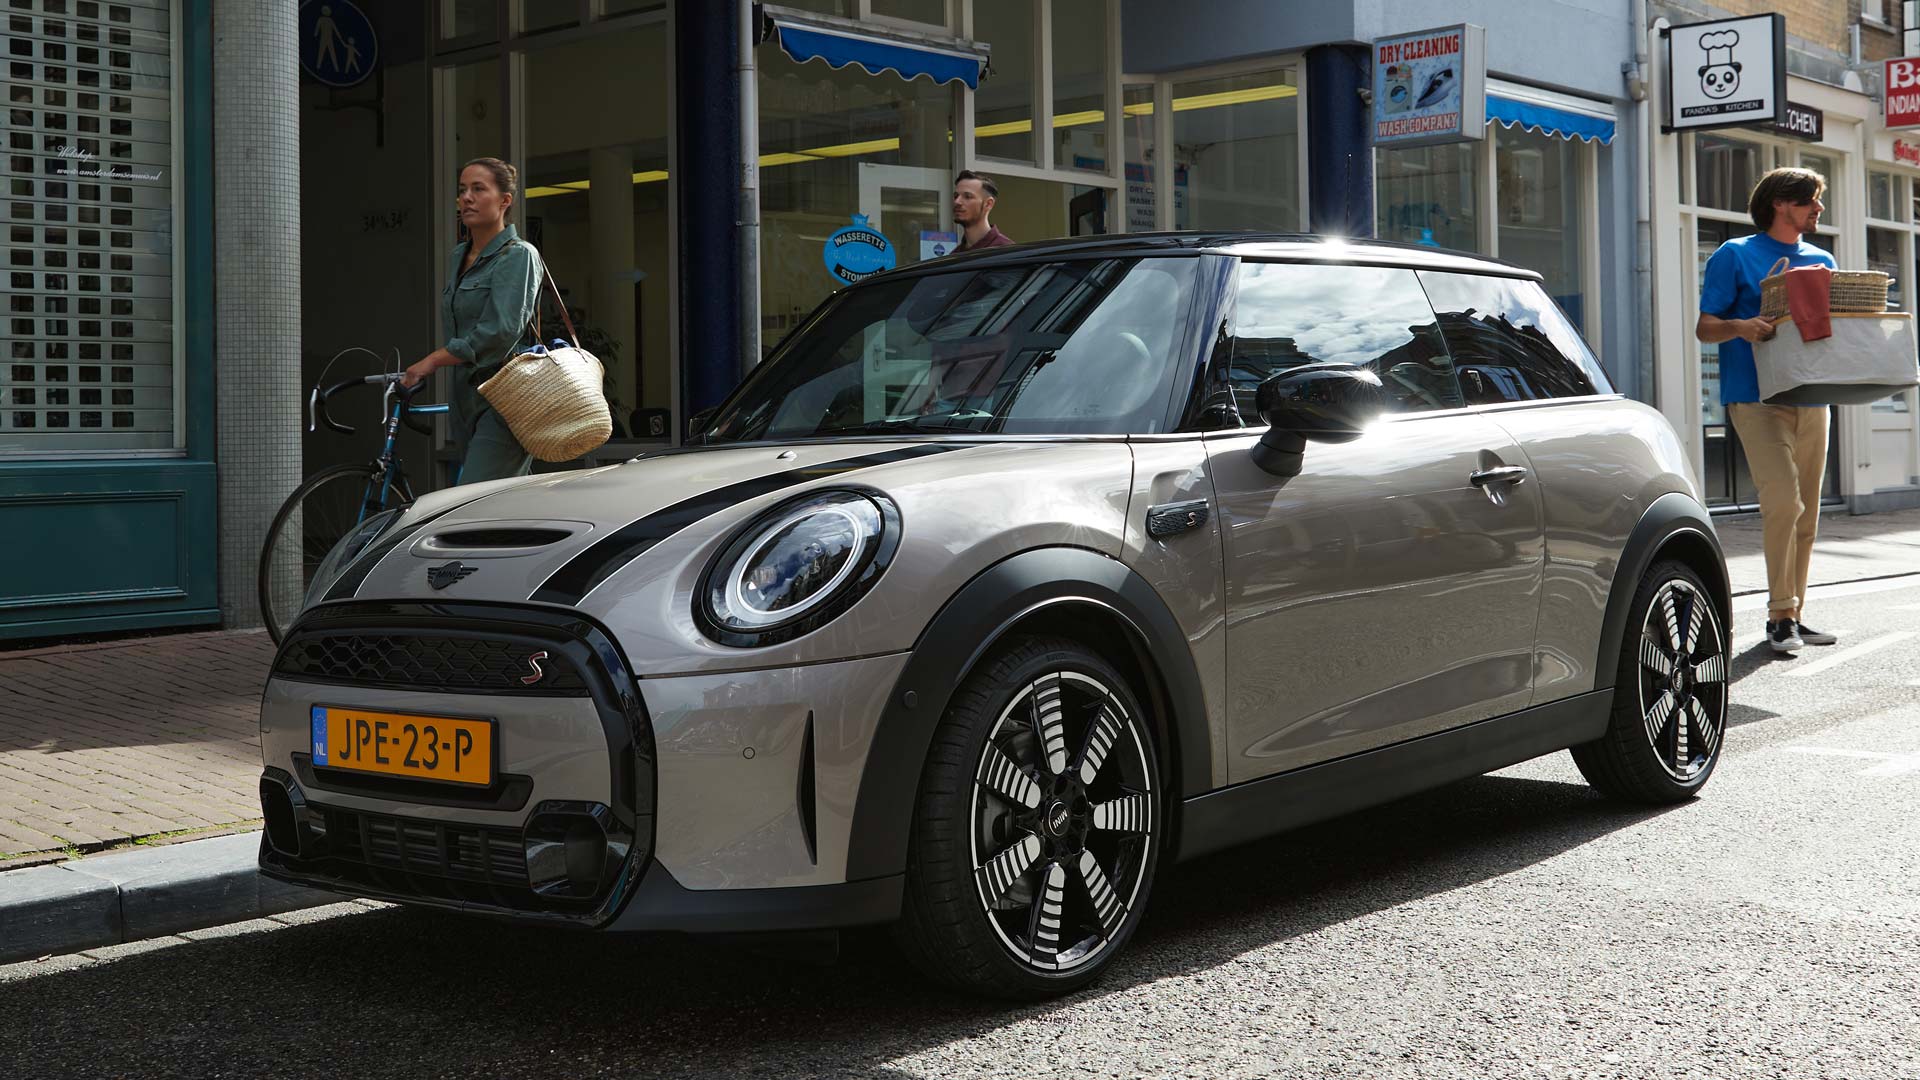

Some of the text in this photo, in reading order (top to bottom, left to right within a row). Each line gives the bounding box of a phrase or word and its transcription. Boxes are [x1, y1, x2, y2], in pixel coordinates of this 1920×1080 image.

[1380, 34, 1459, 64] DRY CLEANING
[1685, 101, 1760, 115] PANDA'S KITCHEN
[1378, 112, 1458, 137] WASH COMPANY
[834, 231, 886, 250] WASSERETTE
[1186, 511, 1197, 527] S
[521, 651, 548, 684] S
[315, 742, 327, 757] NL
[339, 718, 473, 773] JPE-23-P
[1052, 809, 1069, 829] MINI
